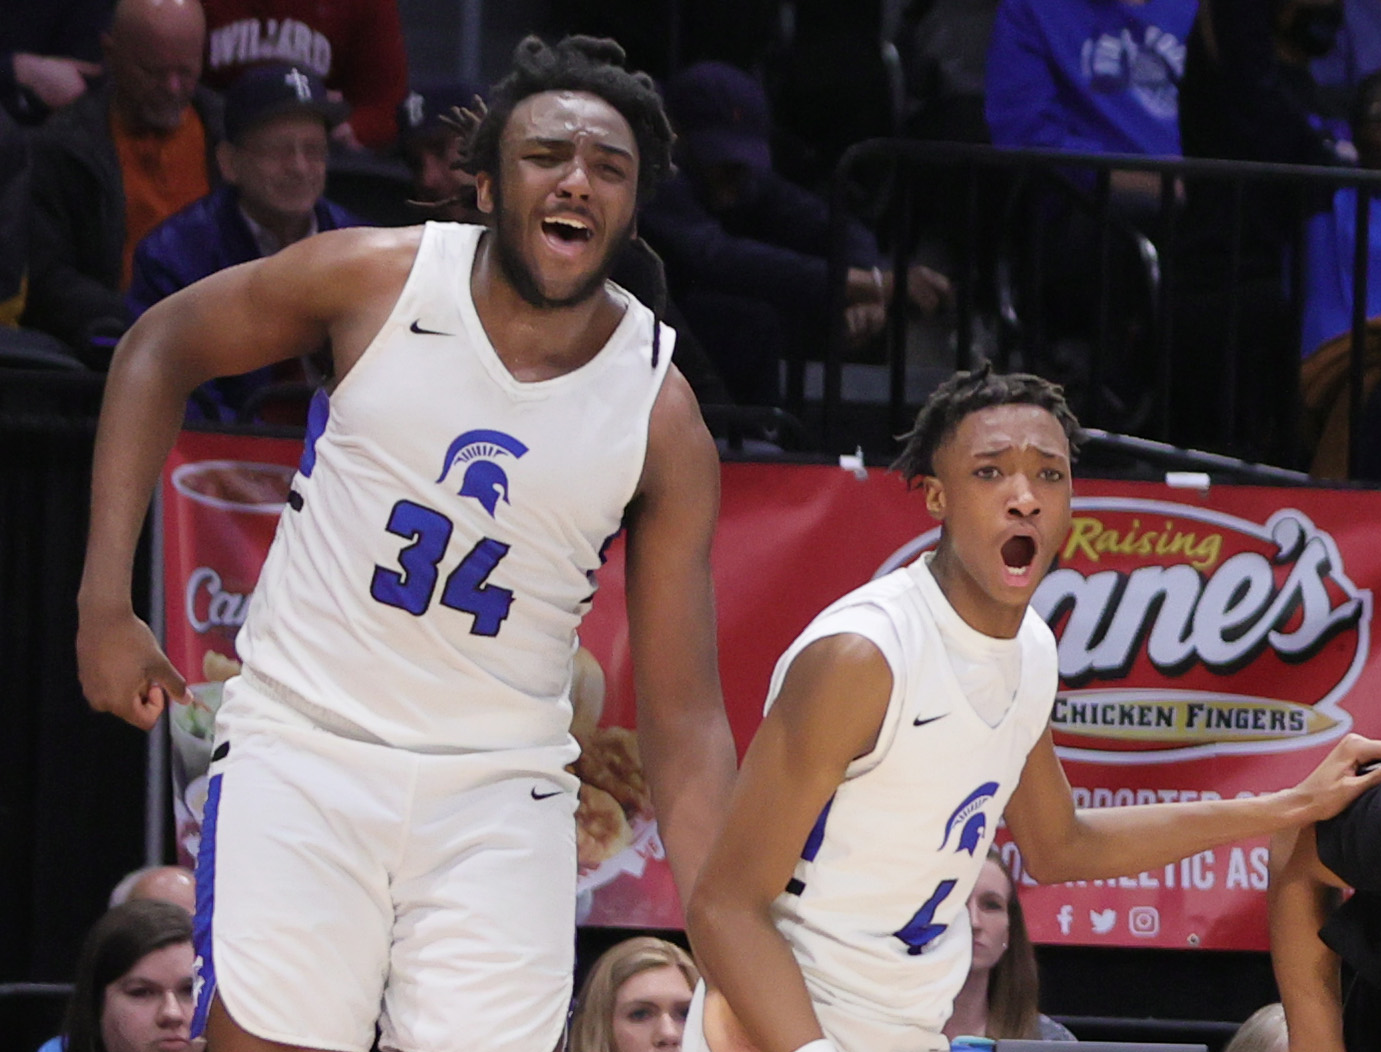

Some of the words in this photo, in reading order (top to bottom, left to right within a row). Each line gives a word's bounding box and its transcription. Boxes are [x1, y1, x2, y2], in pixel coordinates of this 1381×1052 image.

[370, 499, 516, 637] 34
[1063, 517, 1223, 570] Raising
[1029, 515, 1365, 680] ane's
[1185, 704, 1305, 732] FINGERS
